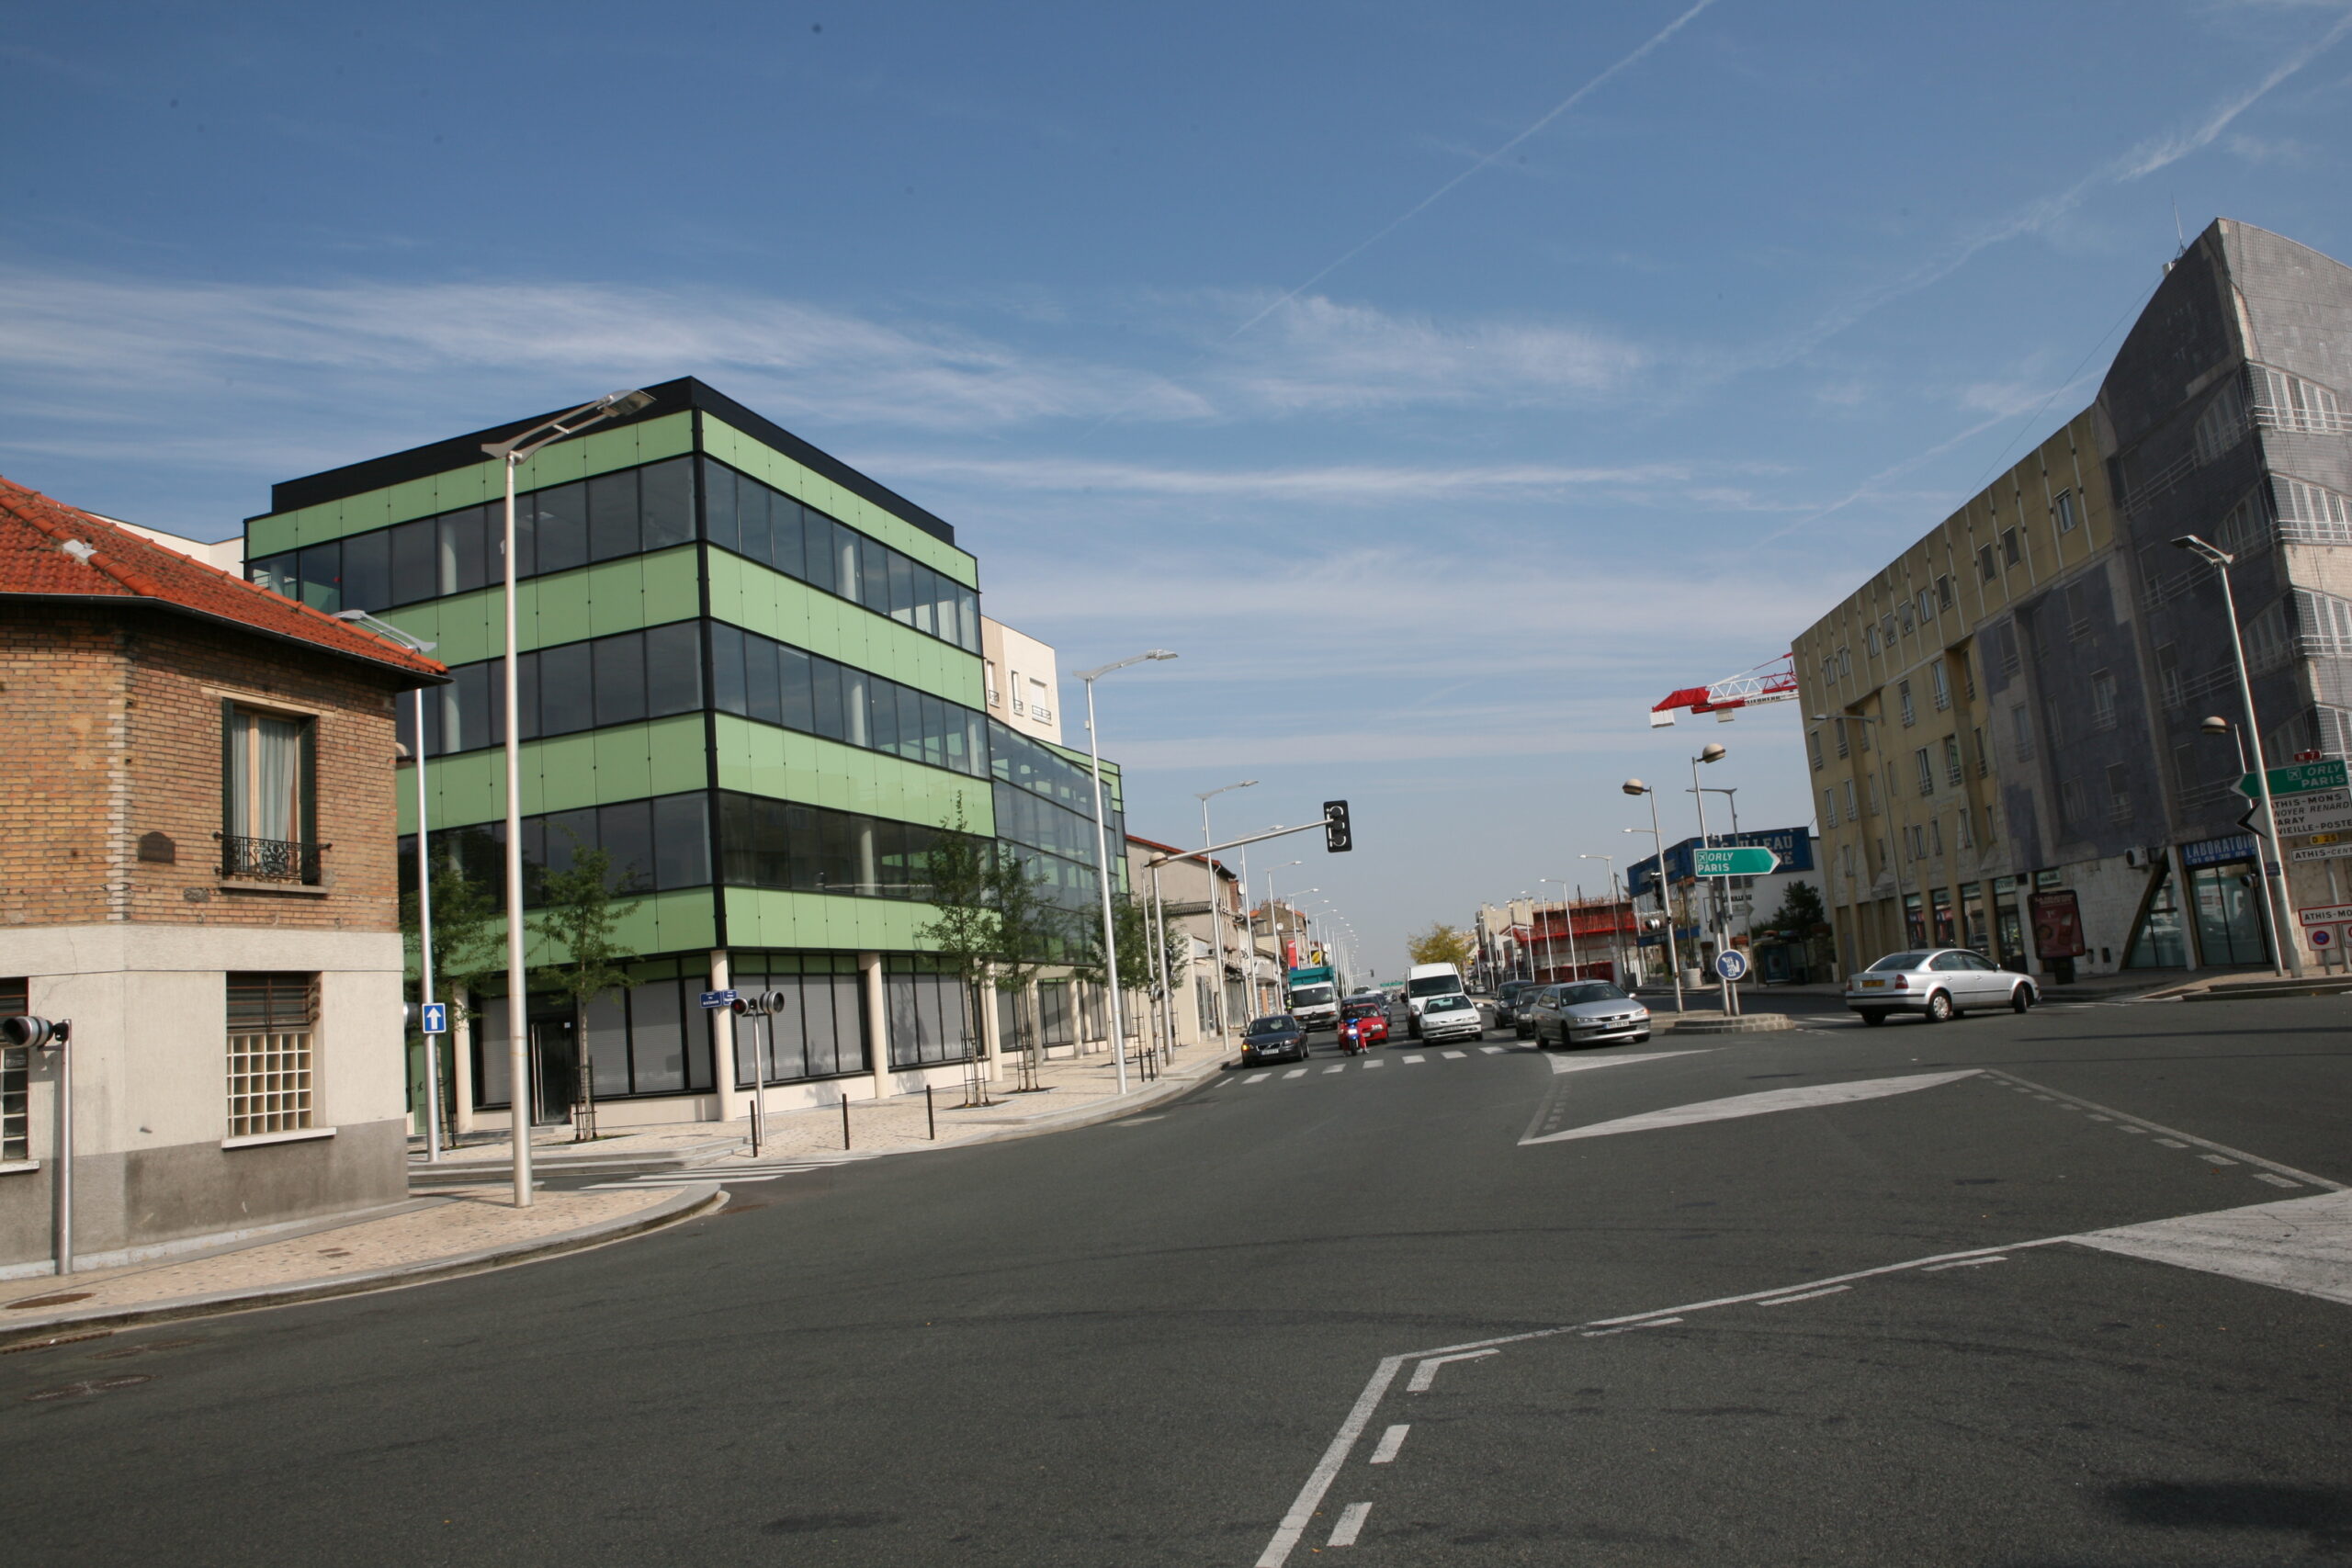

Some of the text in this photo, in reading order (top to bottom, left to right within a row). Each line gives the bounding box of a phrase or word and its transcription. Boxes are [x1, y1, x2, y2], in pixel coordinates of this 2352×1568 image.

[2308, 763, 2341, 776] ORLY
[2301, 774, 2346, 788] PARIS
[2274, 802, 2349, 818] NOYER RENARD
[2274, 817, 2304, 826] ARAY
[2277, 818, 2352, 835] VIEILLE-POSTE
[1708, 852, 1734, 862] ORLY
[1697, 863, 1730, 873] PARIS
